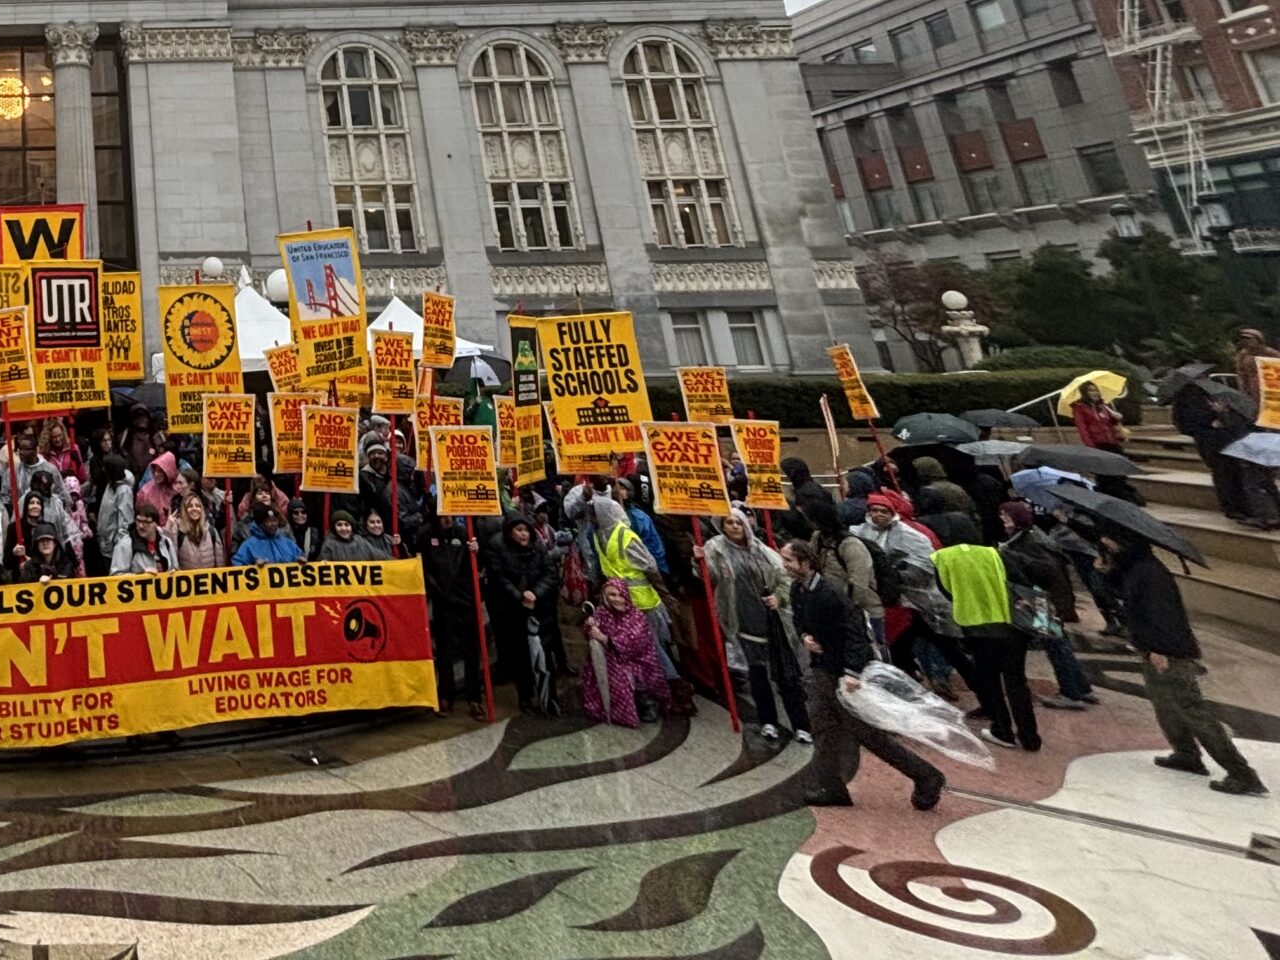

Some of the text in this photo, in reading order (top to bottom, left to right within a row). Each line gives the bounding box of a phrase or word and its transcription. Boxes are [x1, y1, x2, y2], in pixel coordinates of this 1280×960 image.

[316, 251, 349, 259] FRANCISCO
[41, 278, 92, 323] UTR
[302, 326, 315, 339] WE
[557, 319, 611, 345] FULLY
[384, 339, 405, 348] WE
[35, 351, 50, 364] WE
[275, 350, 290, 359] WE
[549, 344, 629, 371] STAFFED
[376, 357, 409, 367] WAIT
[45, 369, 70, 380] INVEST
[82, 368, 94, 378] THE
[273, 367, 297, 377] WAIT
[169, 372, 239, 386] WE CAN'T WAIT
[552, 369, 639, 397] SCHOOLS
[46, 381, 79, 391] SCHOOLS
[36, 390, 106, 404] STUDENTS DESERVE
[180, 391, 202, 402] INVES
[218, 402, 242, 411] WE
[171, 414, 203, 426] STUDENT
[209, 421, 248, 430] WAIT
[320, 415, 344, 425] NO
[314, 425, 351, 437] PODEMOS
[562, 427, 618, 445] WE CAN'T
[663, 431, 698, 442] WE
[746, 427, 767, 438] NO
[316, 437, 349, 448] ESPERAR
[450, 434, 478, 445] NO
[446, 445, 487, 457] PODEMOS
[450, 458, 487, 470] ESPERAR
[655, 452, 711, 464] WAIT
[43, 581, 106, 610] OUR
[116, 568, 260, 603] STUDENTS
[269, 564, 383, 588] DESERVE
[142, 601, 316, 672] WAIT
[188, 667, 352, 696] LIVING WAGE FOR
[72, 691, 114, 711] FOR
[215, 689, 328, 713] EDUCATORS
[9, 714, 120, 740] STUDENTS
